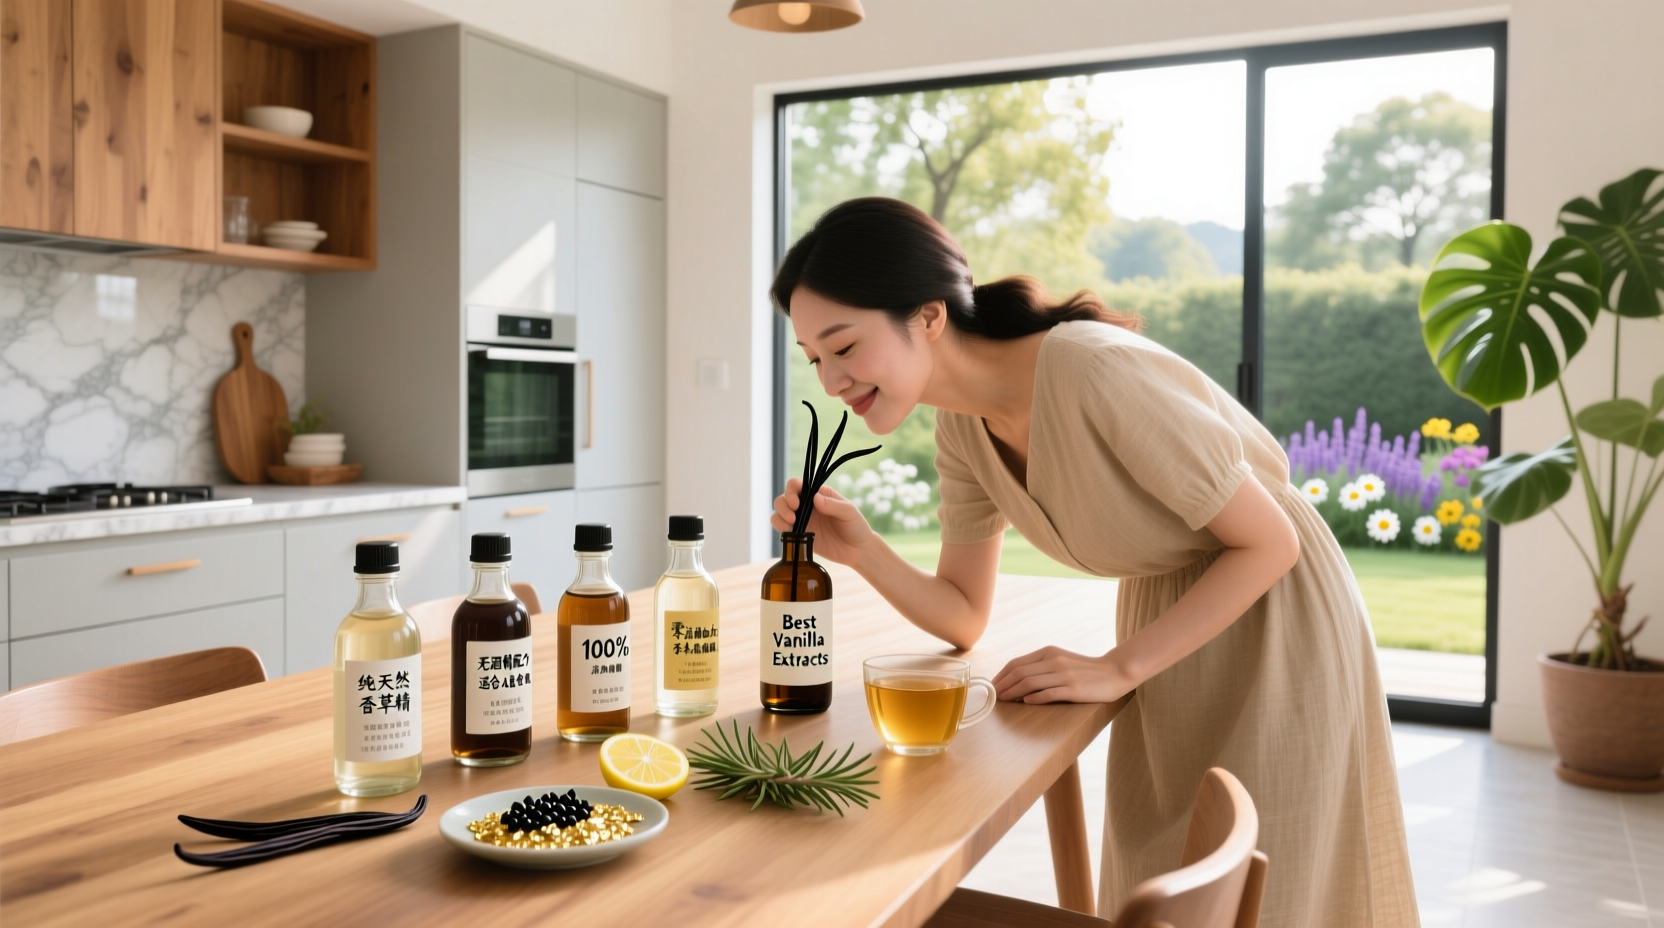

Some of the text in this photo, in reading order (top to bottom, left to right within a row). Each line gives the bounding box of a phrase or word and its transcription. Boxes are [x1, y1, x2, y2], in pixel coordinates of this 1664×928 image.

[782, 614, 817, 630] Best
[581, 635, 630, 660] 100%
[772, 630, 825, 649] Vanilla
[772, 651, 829, 667] Extracts
[357, 670, 411, 692] 纯天然
[358, 691, 411, 715] 香草精
